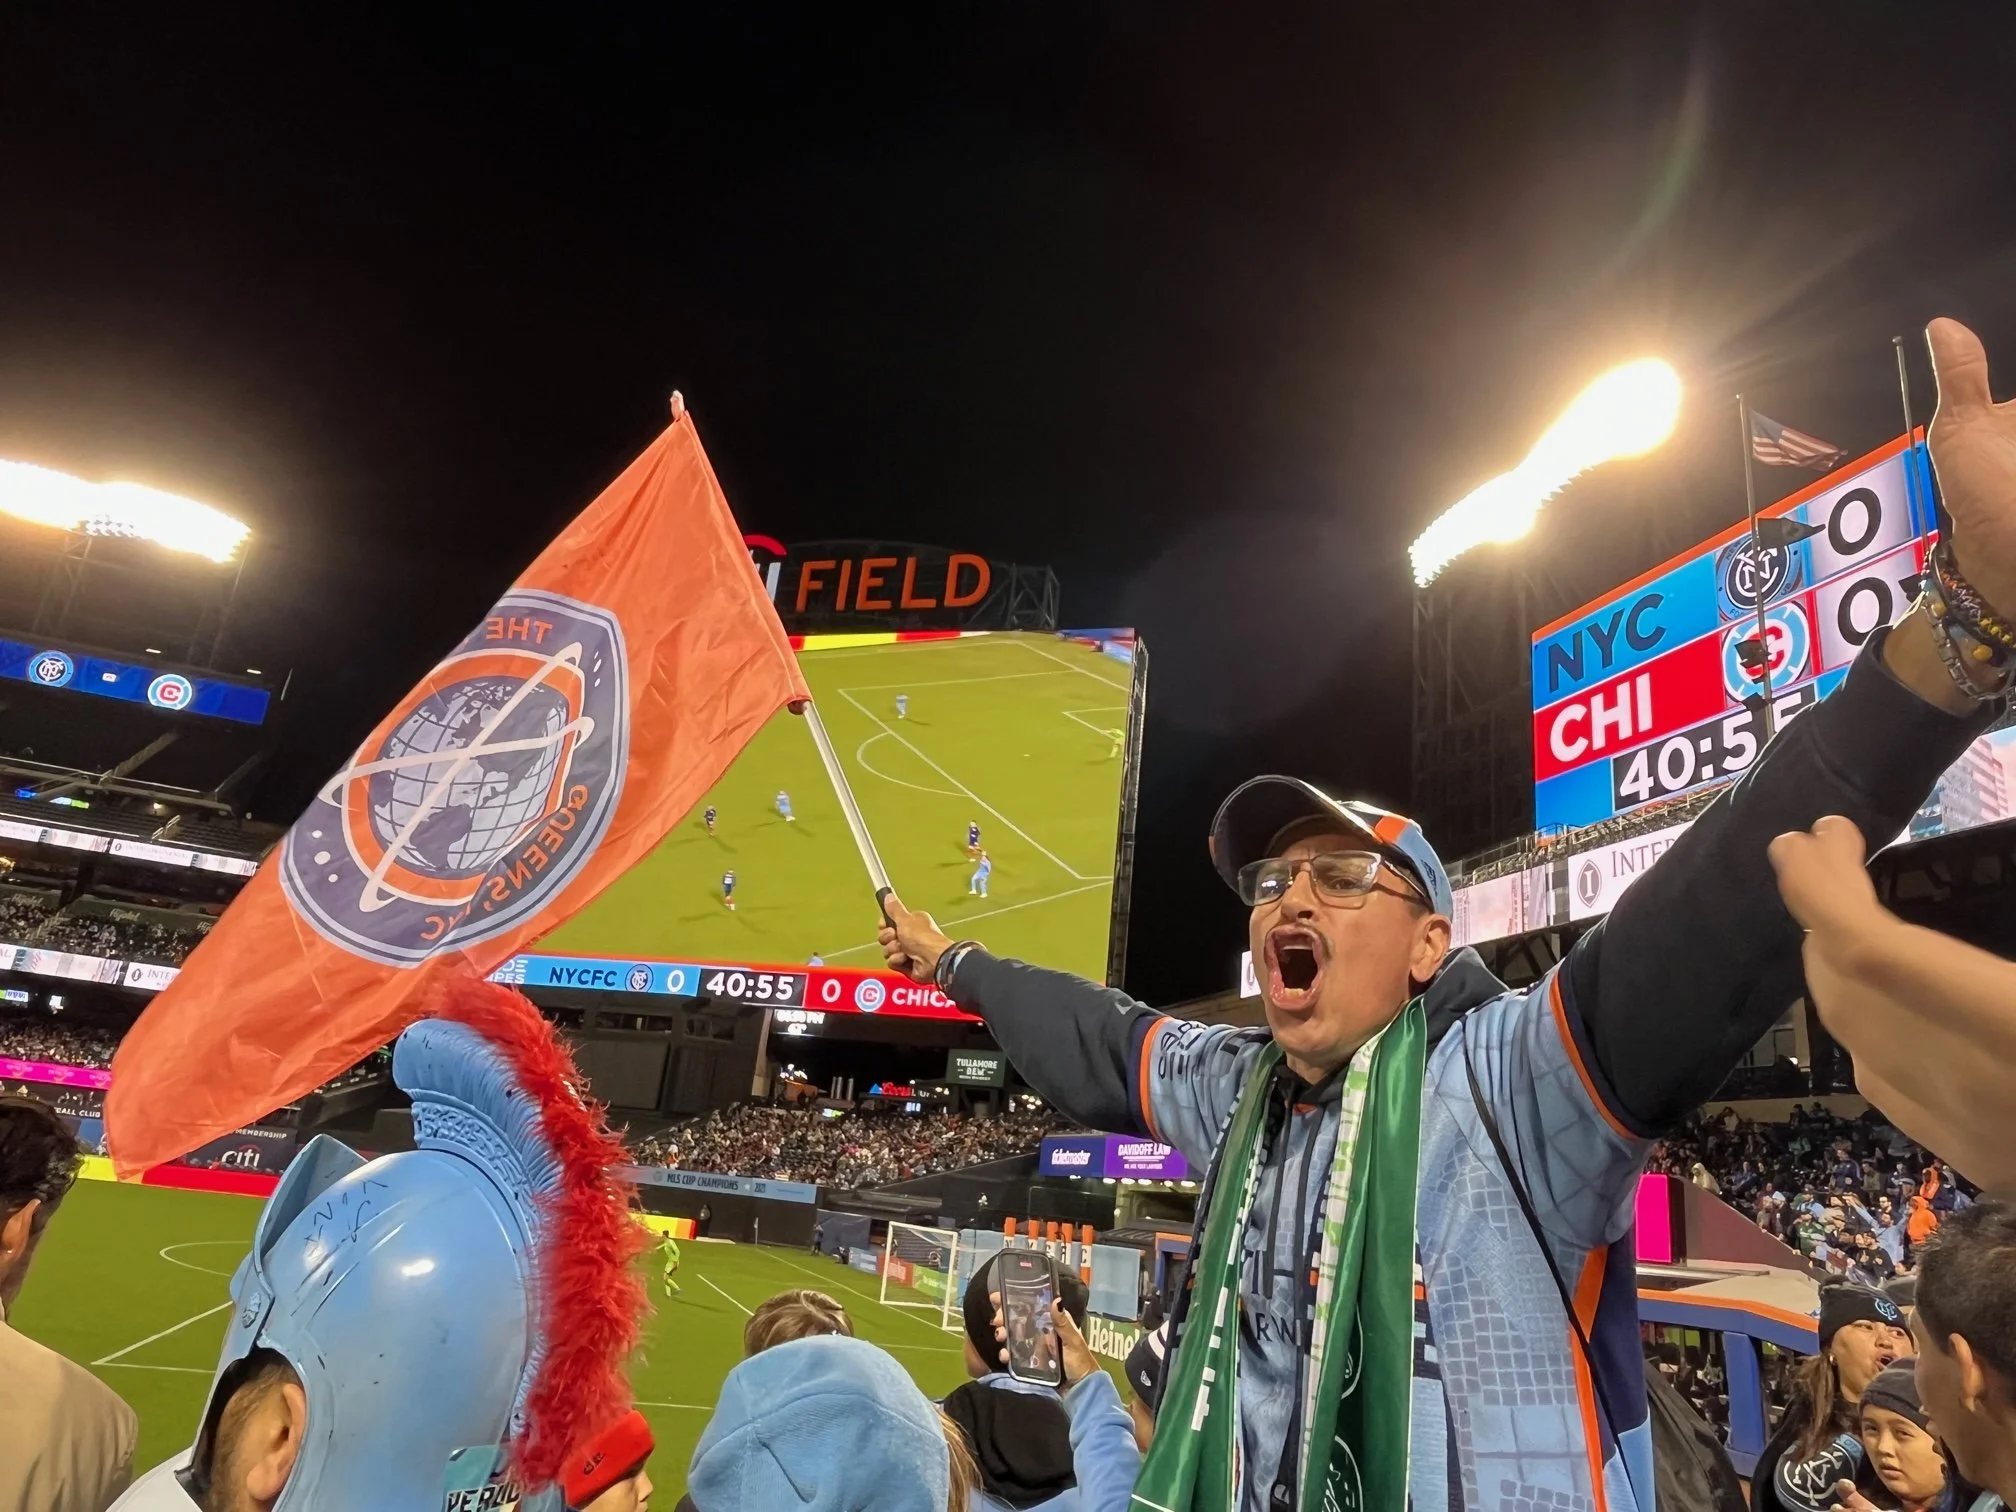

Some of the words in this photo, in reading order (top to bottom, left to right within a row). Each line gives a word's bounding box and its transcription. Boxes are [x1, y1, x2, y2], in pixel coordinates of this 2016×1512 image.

[1828, 487, 1882, 556] 0
[796, 553, 991, 613] FIELD
[1837, 577, 1893, 646] 0
[1548, 593, 1667, 693] NYC
[1550, 672, 1653, 762] CHI
[549, 966, 618, 987] NYCFC
[666, 970, 685, 993] 0
[705, 973, 794, 1000] 40:55
[822, 979, 841, 1002] 0
[956, 1057, 998, 1070] TULLAMORE
[1118, 1143, 1154, 1157] DAVIDOFF
[1153, 1142, 1172, 1157] LAW
[666, 1173, 681, 1185] MLS
[681, 1174, 696, 1186] CUP
[696, 1175, 740, 1191] CHAMPIONS
